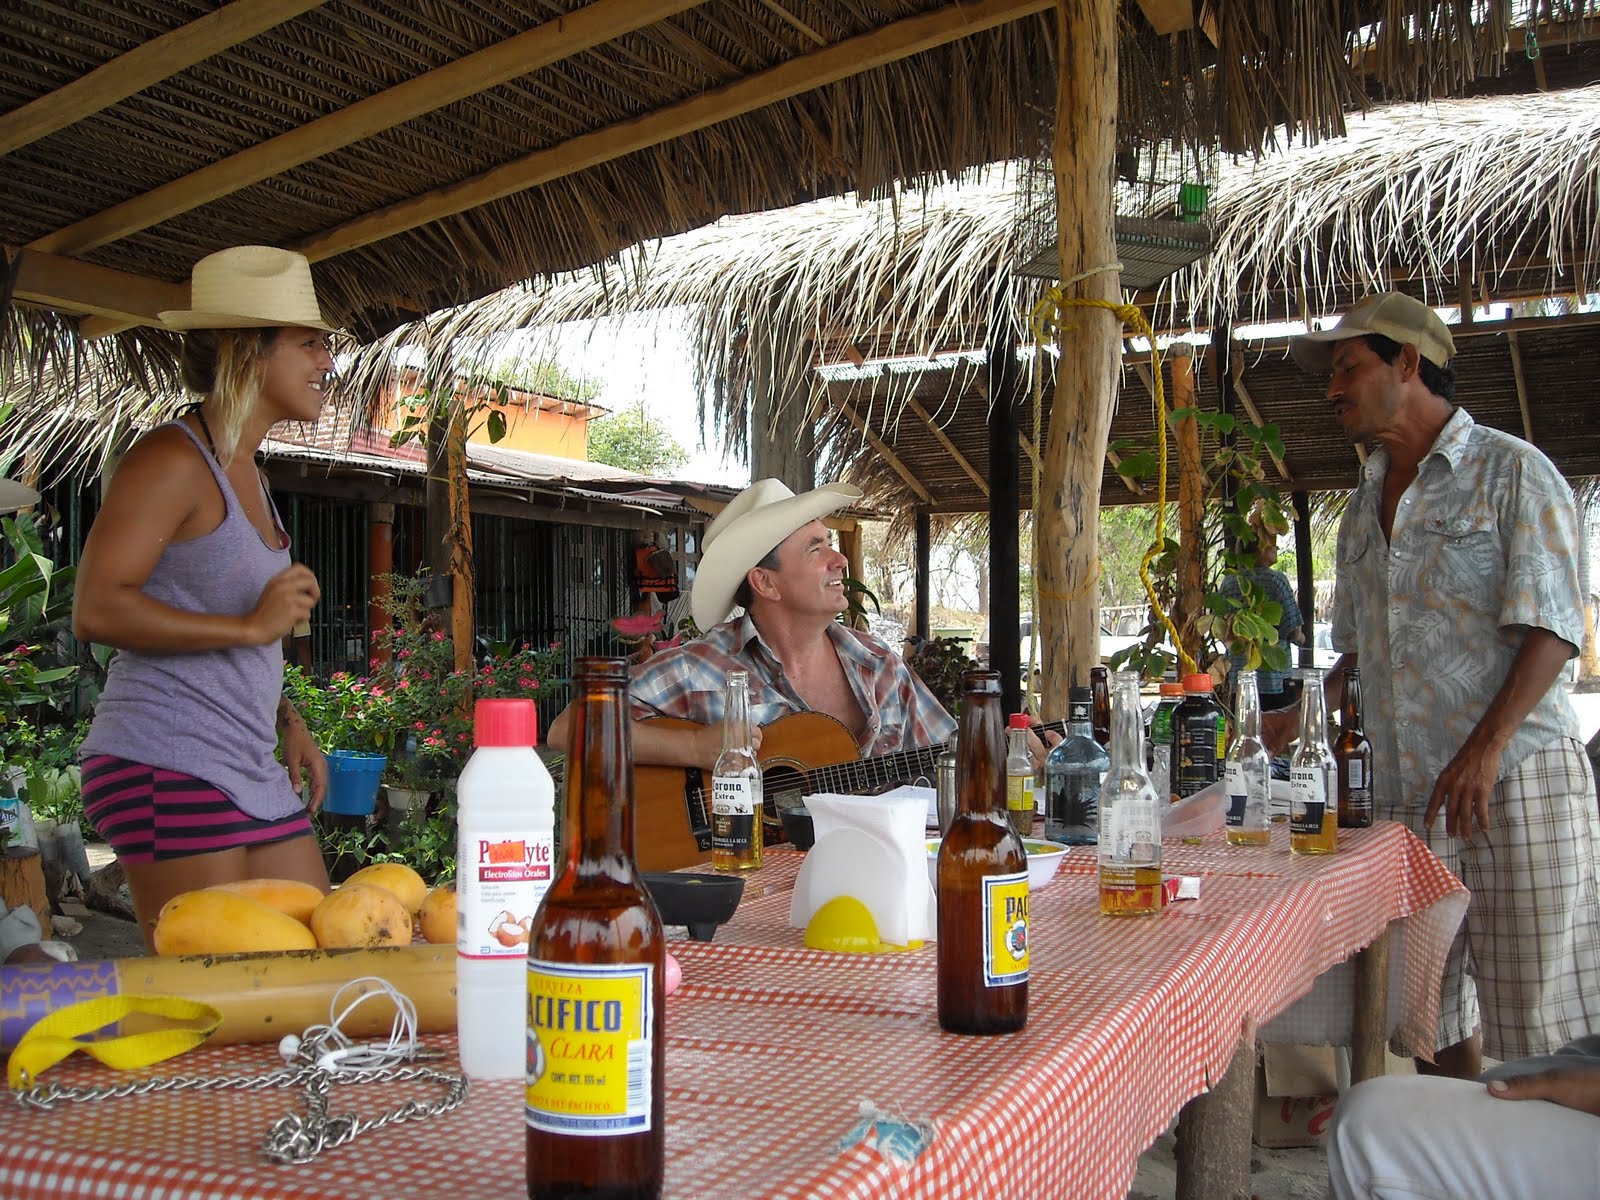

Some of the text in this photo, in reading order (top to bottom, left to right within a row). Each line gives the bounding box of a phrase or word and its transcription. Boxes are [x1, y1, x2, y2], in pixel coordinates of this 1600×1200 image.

[479, 840, 549, 868] Plyte
[484, 868, 547, 879] Electrolitos Orales
[550, 1036, 614, 1062] CLARA
